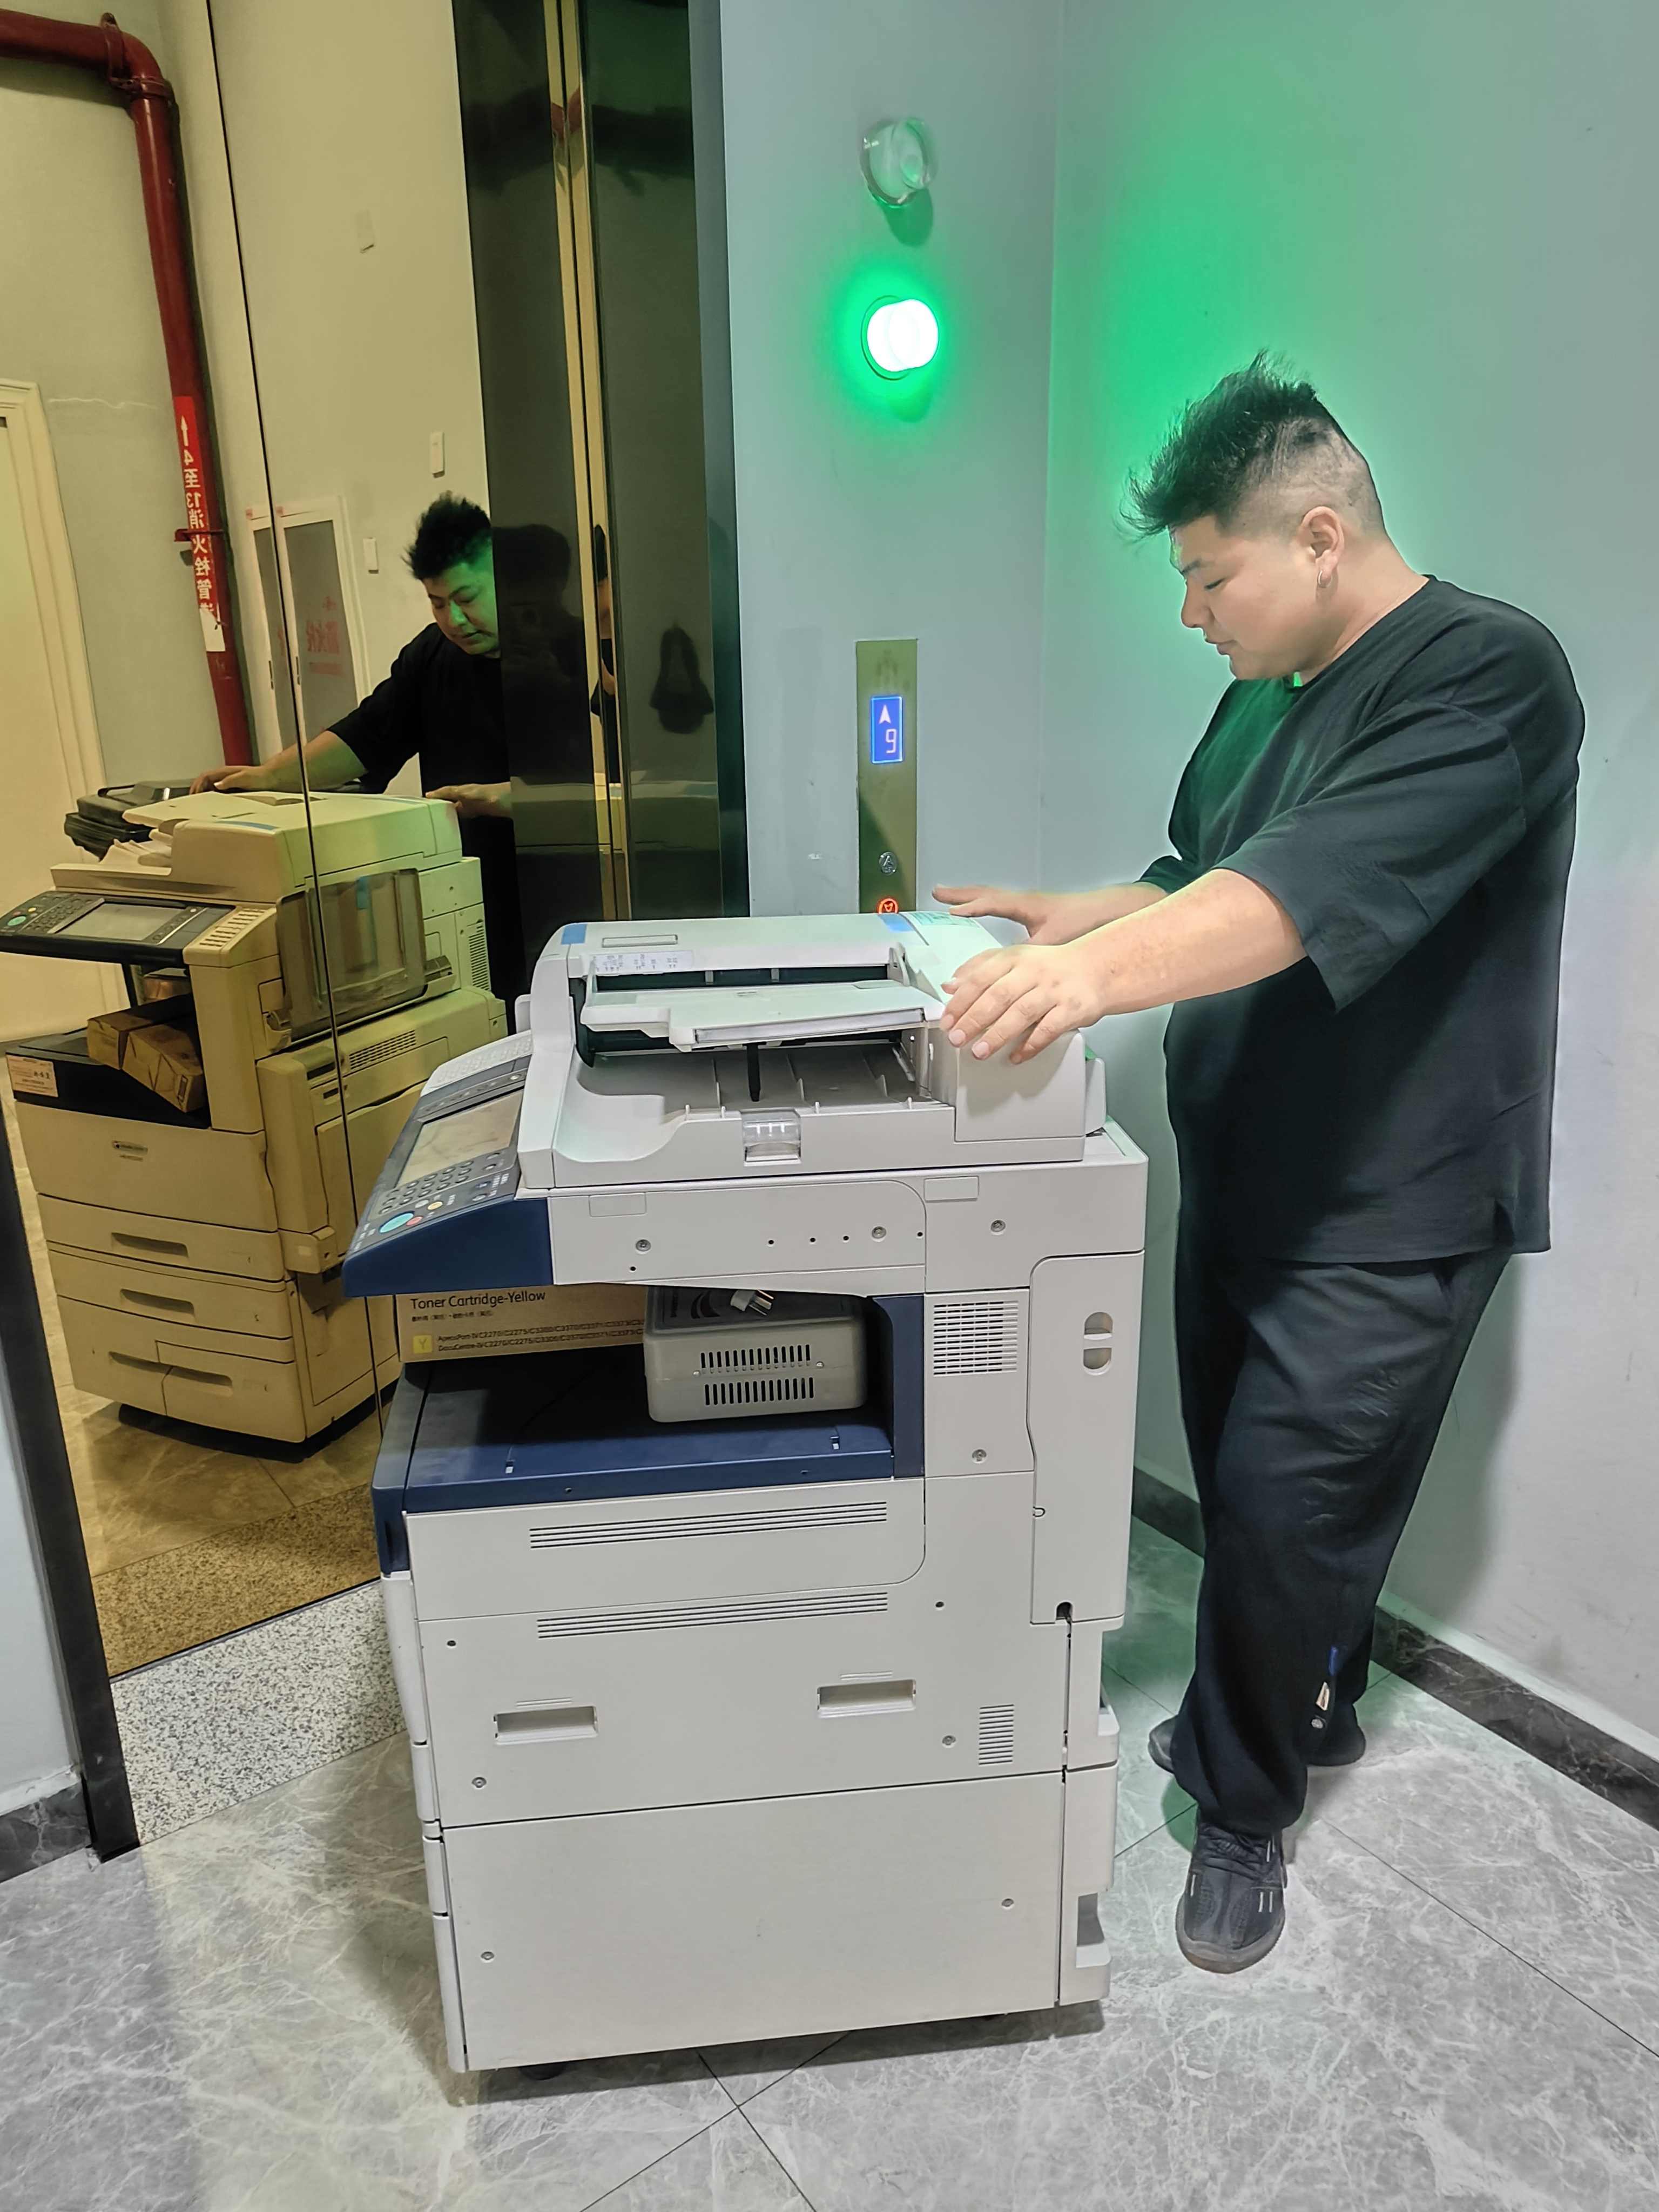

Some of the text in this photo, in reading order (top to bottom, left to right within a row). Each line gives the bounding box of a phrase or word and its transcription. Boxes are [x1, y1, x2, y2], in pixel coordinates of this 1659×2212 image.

[885, 729, 897, 754] 9
[410, 1291, 545, 1309] Toner Cartridge-Yellow
[419, 1337, 427, 1350] Y
